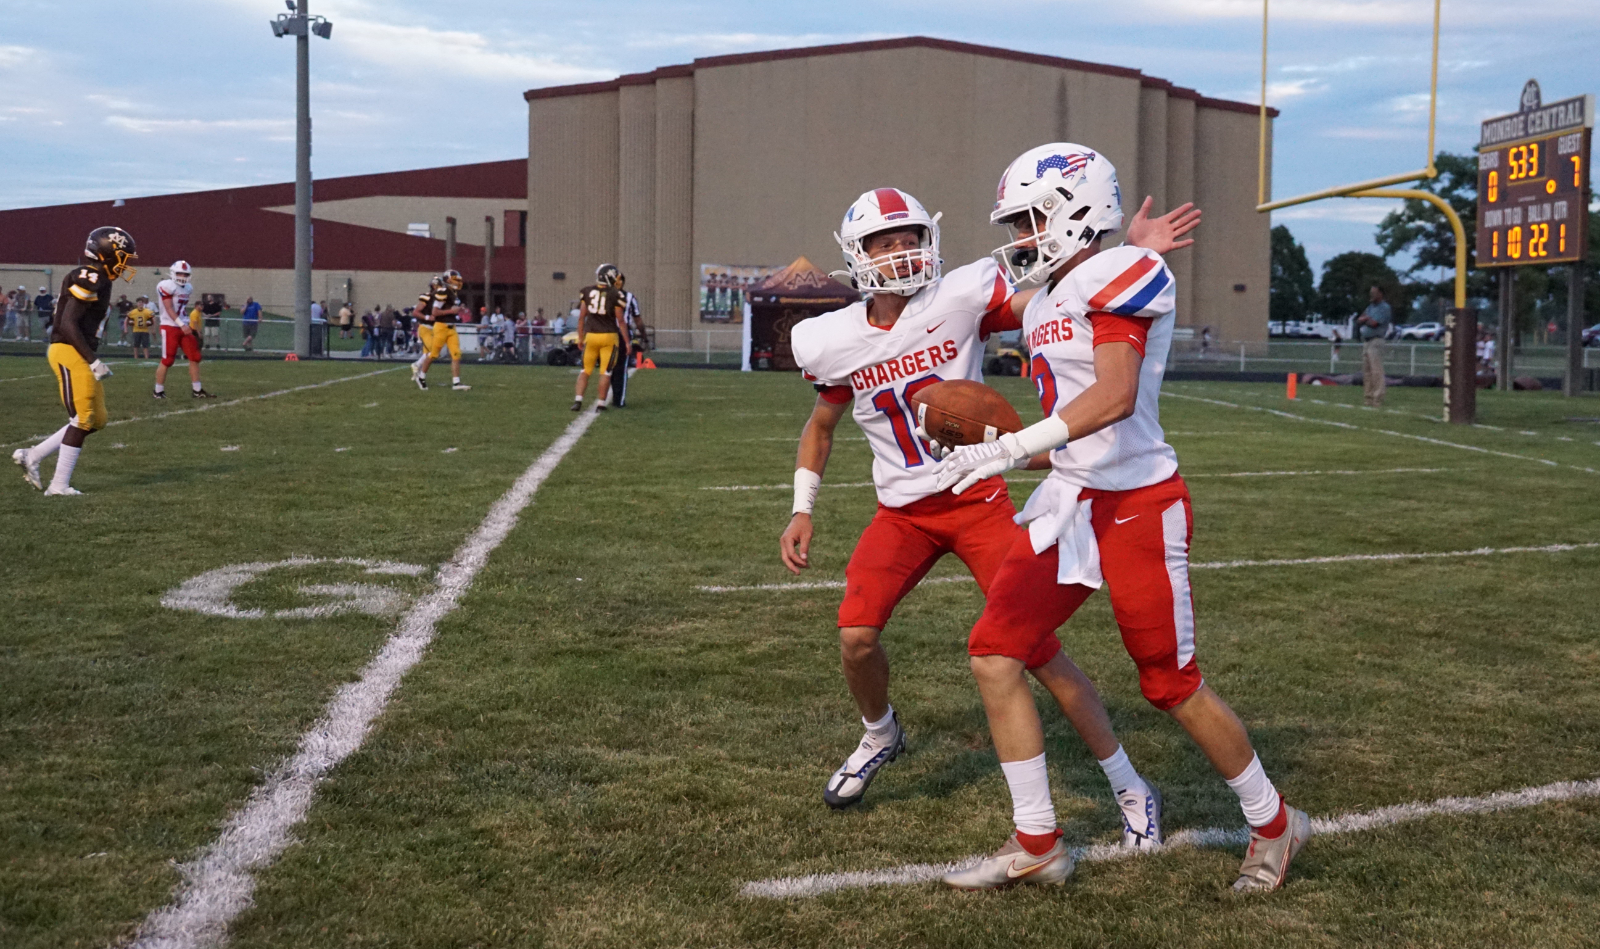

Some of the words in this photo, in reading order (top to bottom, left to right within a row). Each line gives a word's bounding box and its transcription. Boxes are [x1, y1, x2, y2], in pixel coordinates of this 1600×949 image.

[1482, 115, 1525, 146] MONROE
[1527, 101, 1582, 134] CENTRAL
[1557, 133, 1582, 155] GUEST
[1487, 170, 1499, 203] 0
[1570, 155, 1581, 188] 7
[1492, 230, 1499, 258] 1
[1507, 226, 1522, 259] 10
[1528, 223, 1549, 258] 22
[1559, 223, 1566, 253] 1
[588, 289, 606, 315] 31
[850, 339, 959, 391] CHARGERS
